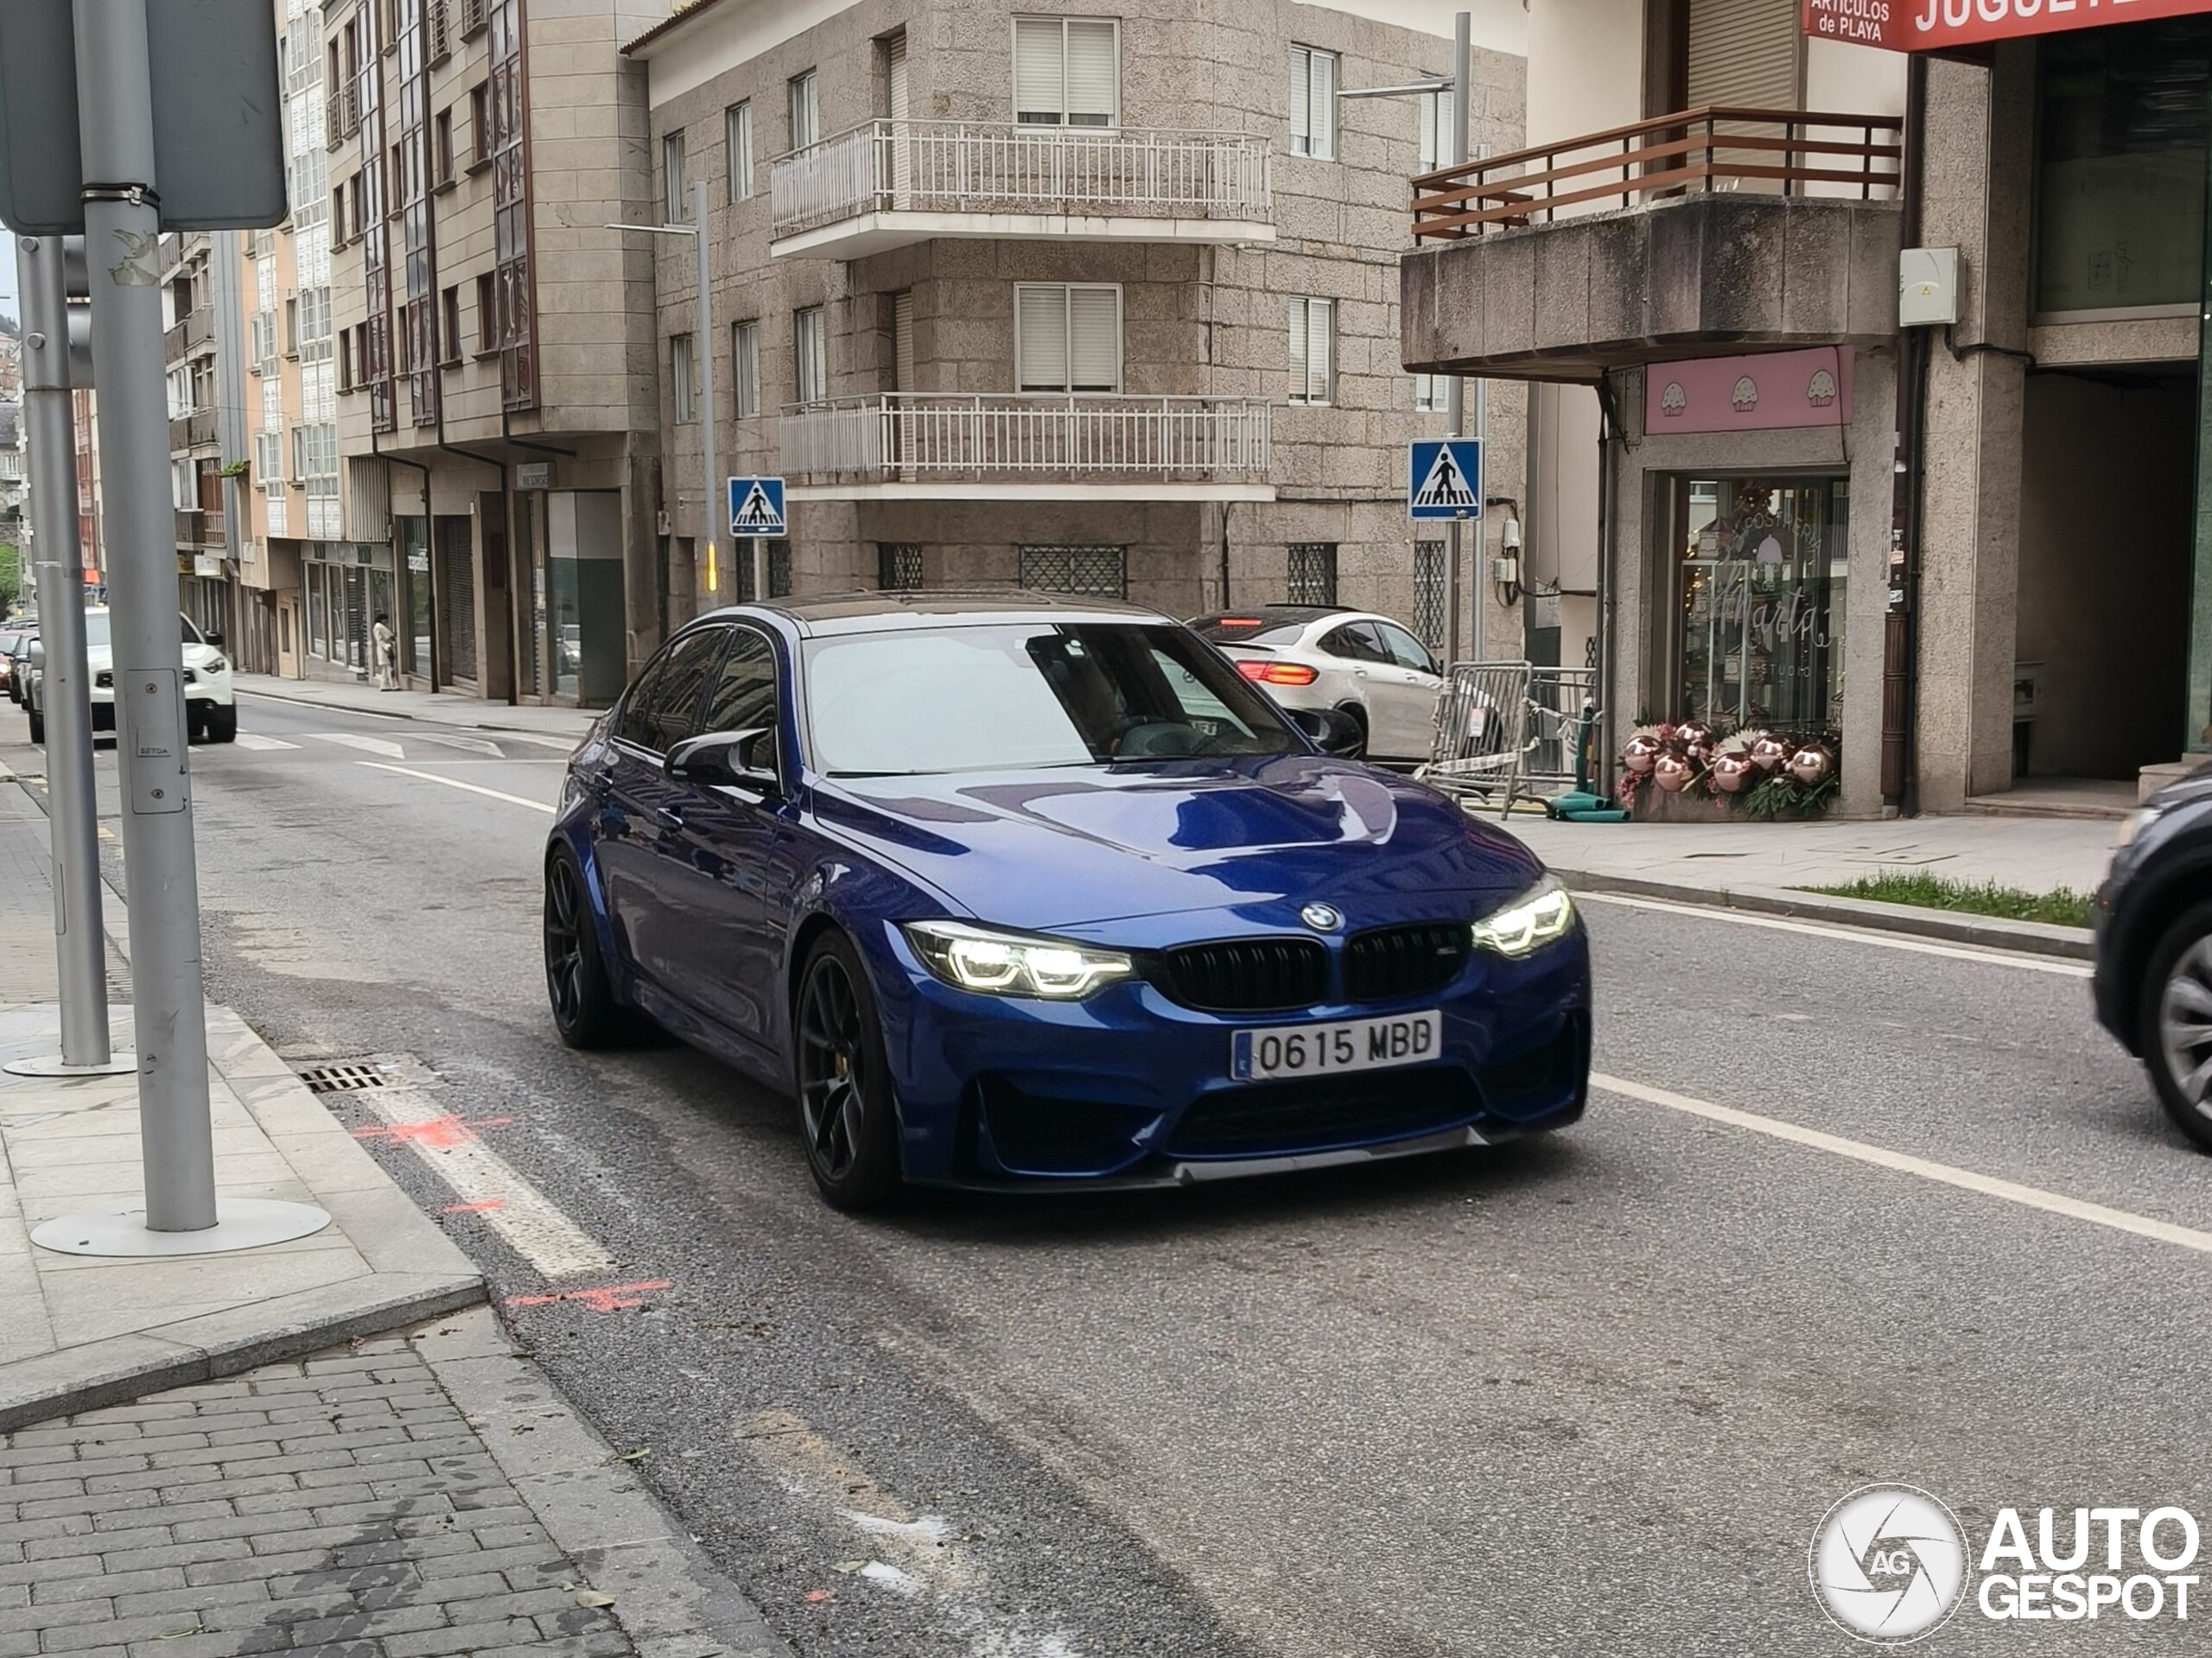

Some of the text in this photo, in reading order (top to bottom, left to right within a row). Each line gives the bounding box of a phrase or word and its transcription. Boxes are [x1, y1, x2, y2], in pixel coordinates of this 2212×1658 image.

[1819, 14, 1881, 41] de PLAYA
[1915, 0, 2140, 31] JUGU
[1713, 557, 1832, 649] Marta
[1750, 663, 1811, 677] ESTUDIO
[1260, 1020, 1432, 1070] 0615 MBD
